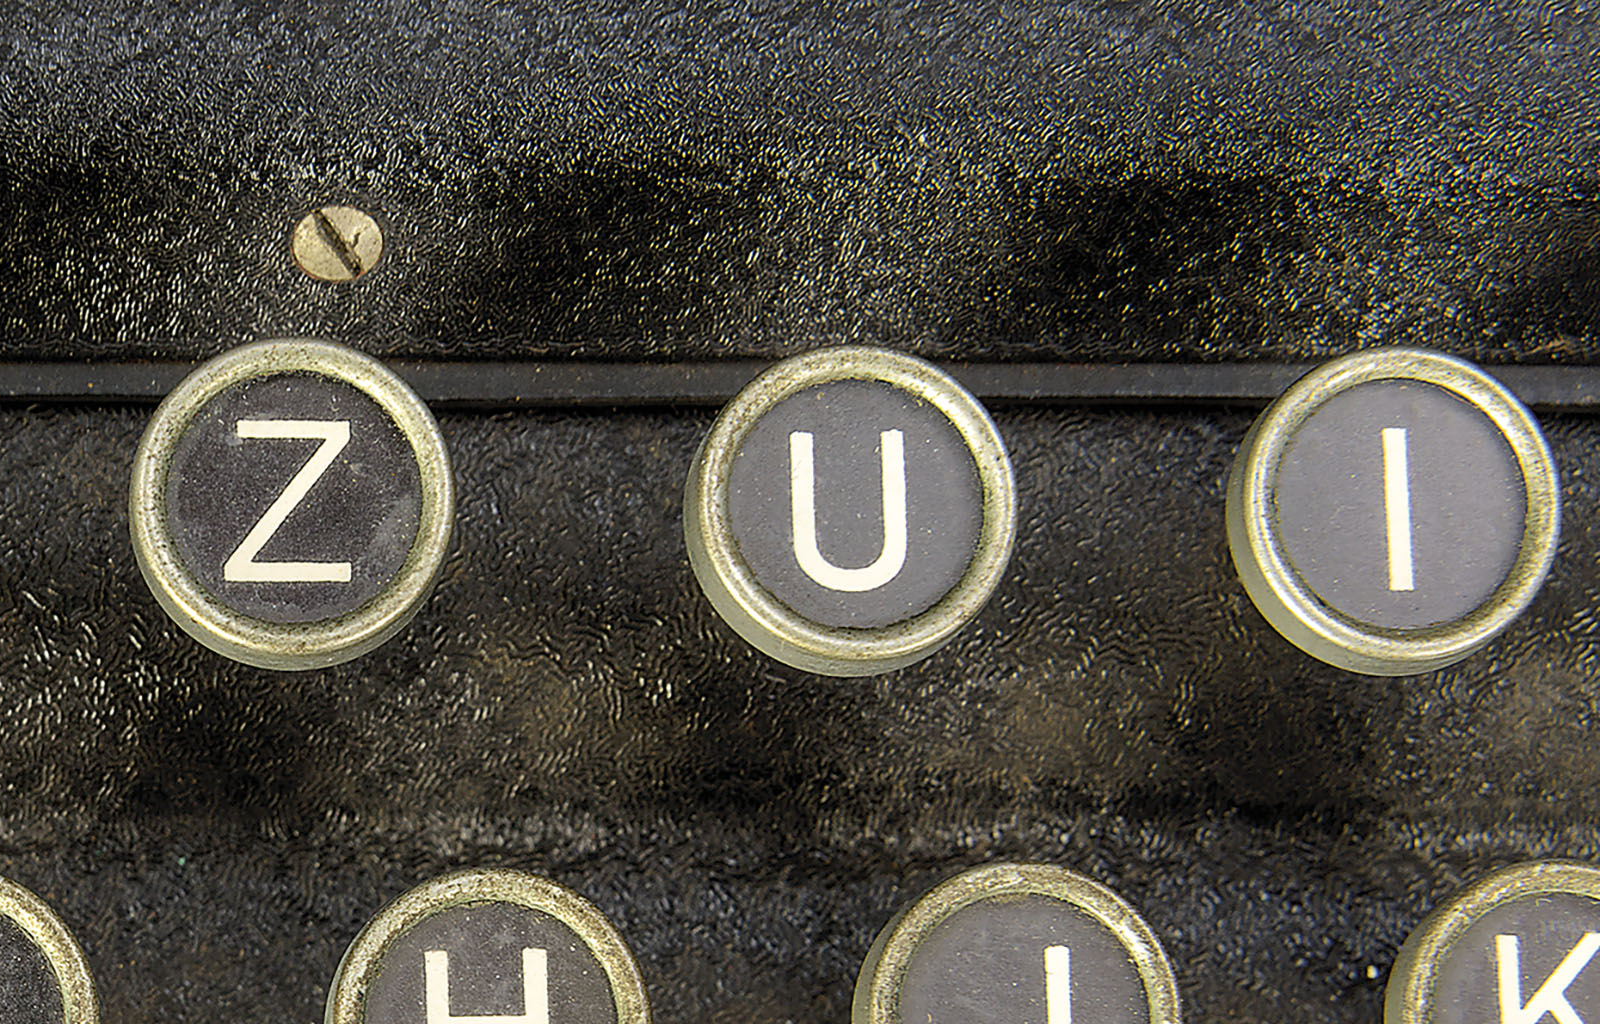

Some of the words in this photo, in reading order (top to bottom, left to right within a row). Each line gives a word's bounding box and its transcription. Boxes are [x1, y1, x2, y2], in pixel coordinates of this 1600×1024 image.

[224, 419, 352, 582] Z
[789, 429, 907, 592] U
[1381, 427, 1415, 591] I
